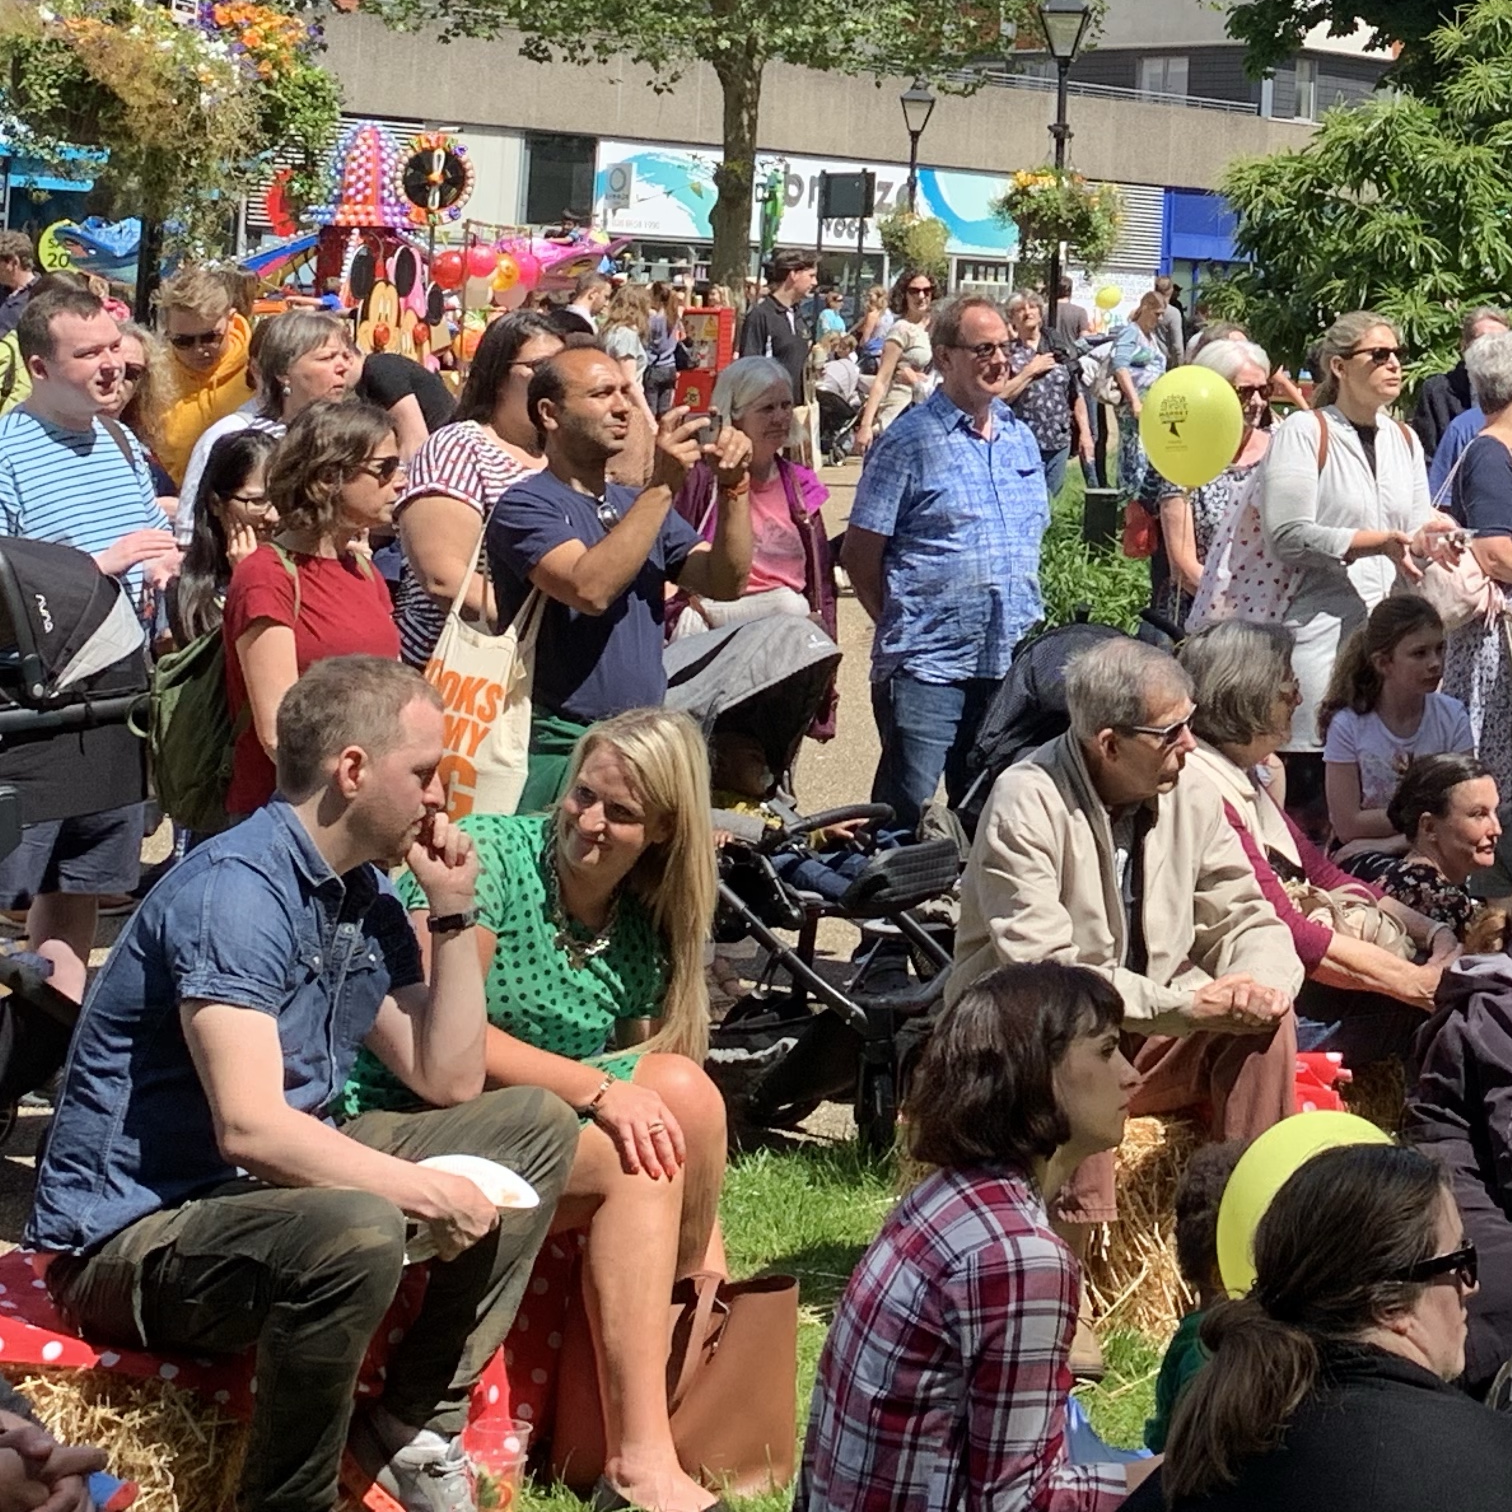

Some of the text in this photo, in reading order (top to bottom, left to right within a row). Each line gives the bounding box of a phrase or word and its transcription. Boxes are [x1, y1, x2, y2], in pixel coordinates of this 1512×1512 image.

[822, 218, 870, 240] YOGA
[47, 253, 70, 268] 20
[425, 659, 505, 724] OOKS
[443, 714, 492, 758] MY
